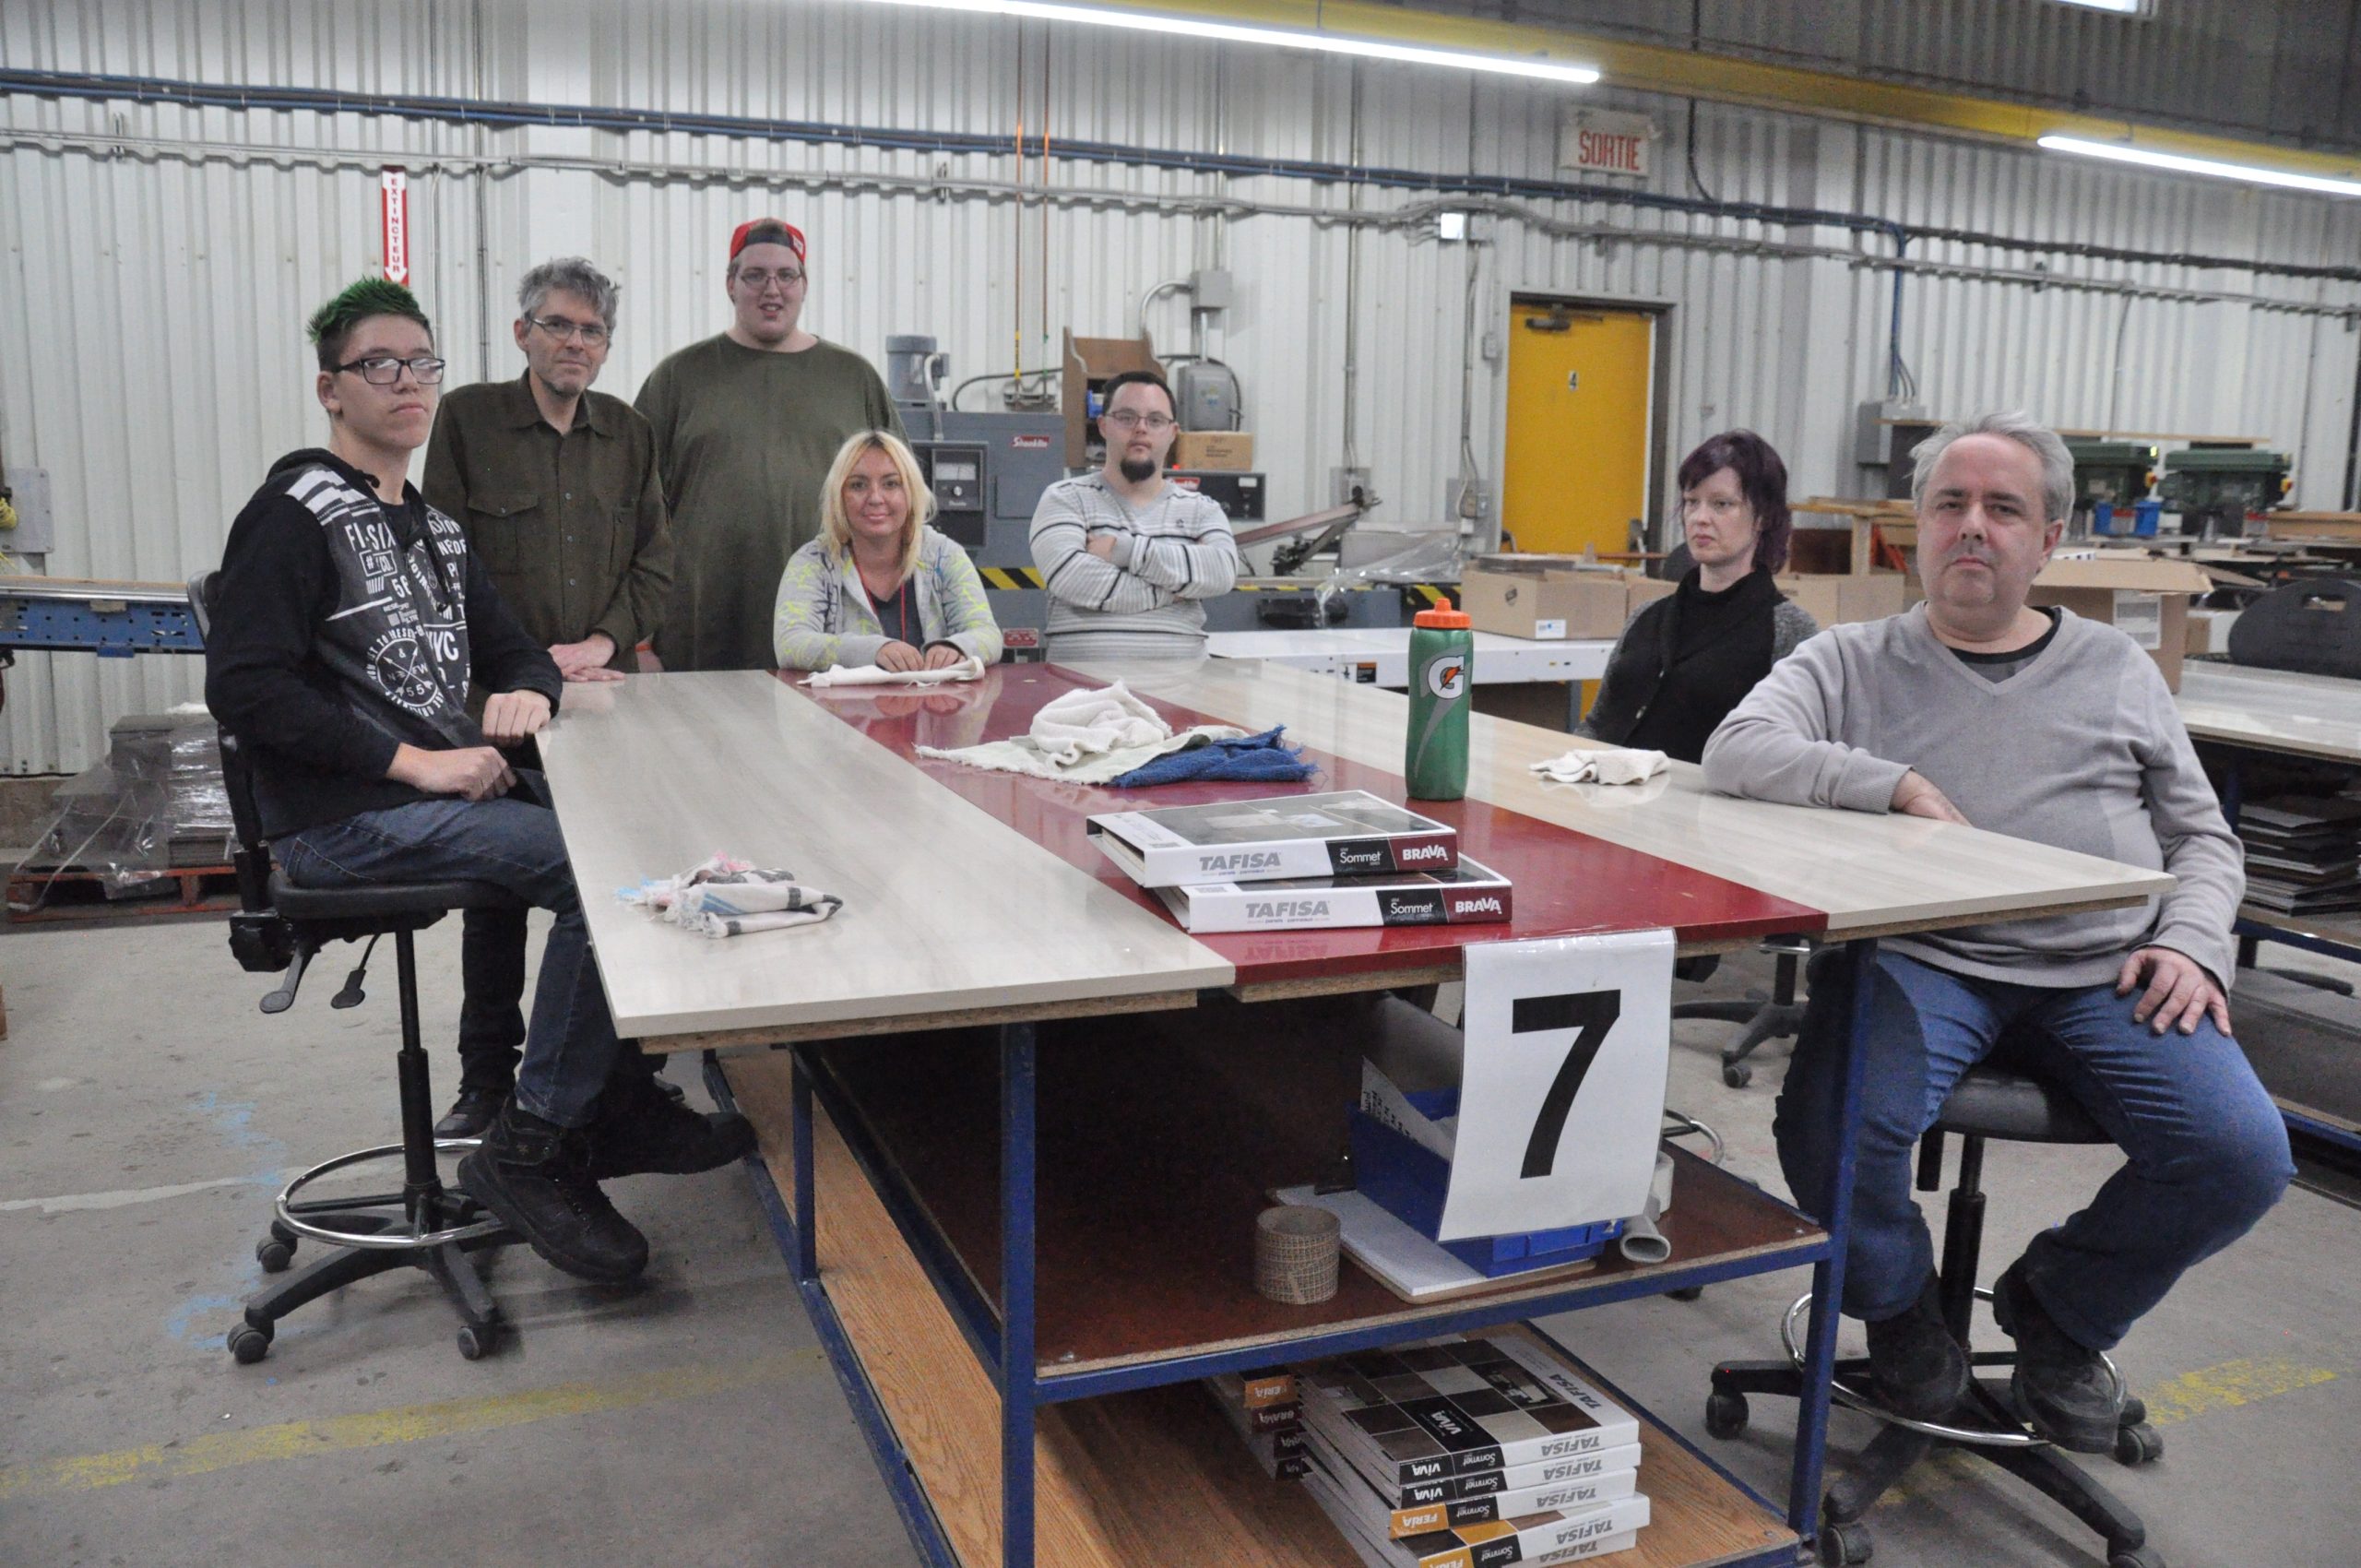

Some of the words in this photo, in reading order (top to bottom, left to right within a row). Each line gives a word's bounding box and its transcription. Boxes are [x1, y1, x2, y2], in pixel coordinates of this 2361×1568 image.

[1578, 130, 1642, 171] SORTIE
[390, 178, 400, 273] EXTINCTEUR
[1199, 851, 1281, 872] TAFISA
[1340, 850, 1381, 864] Sommet
[1403, 845, 1449, 861] BRAVA
[1246, 900, 1330, 919] TAFISA
[1391, 901, 1433, 915] Sommet
[1455, 897, 1502, 914] BRAVA
[1513, 989, 1621, 1180] 7
[1549, 1373, 1602, 1409] TAFISA
[1541, 1435, 1600, 1456] TAFISA
[1463, 1453, 1496, 1467] Sommet
[1543, 1459, 1603, 1480] TAFISA
[1465, 1477, 1499, 1491] Sommet
[1536, 1487, 1596, 1508] TAFISA
[1456, 1504, 1490, 1518] Sommet
[1556, 1519, 1613, 1545] TAFISA
[1481, 1546, 1513, 1562] Sommet
